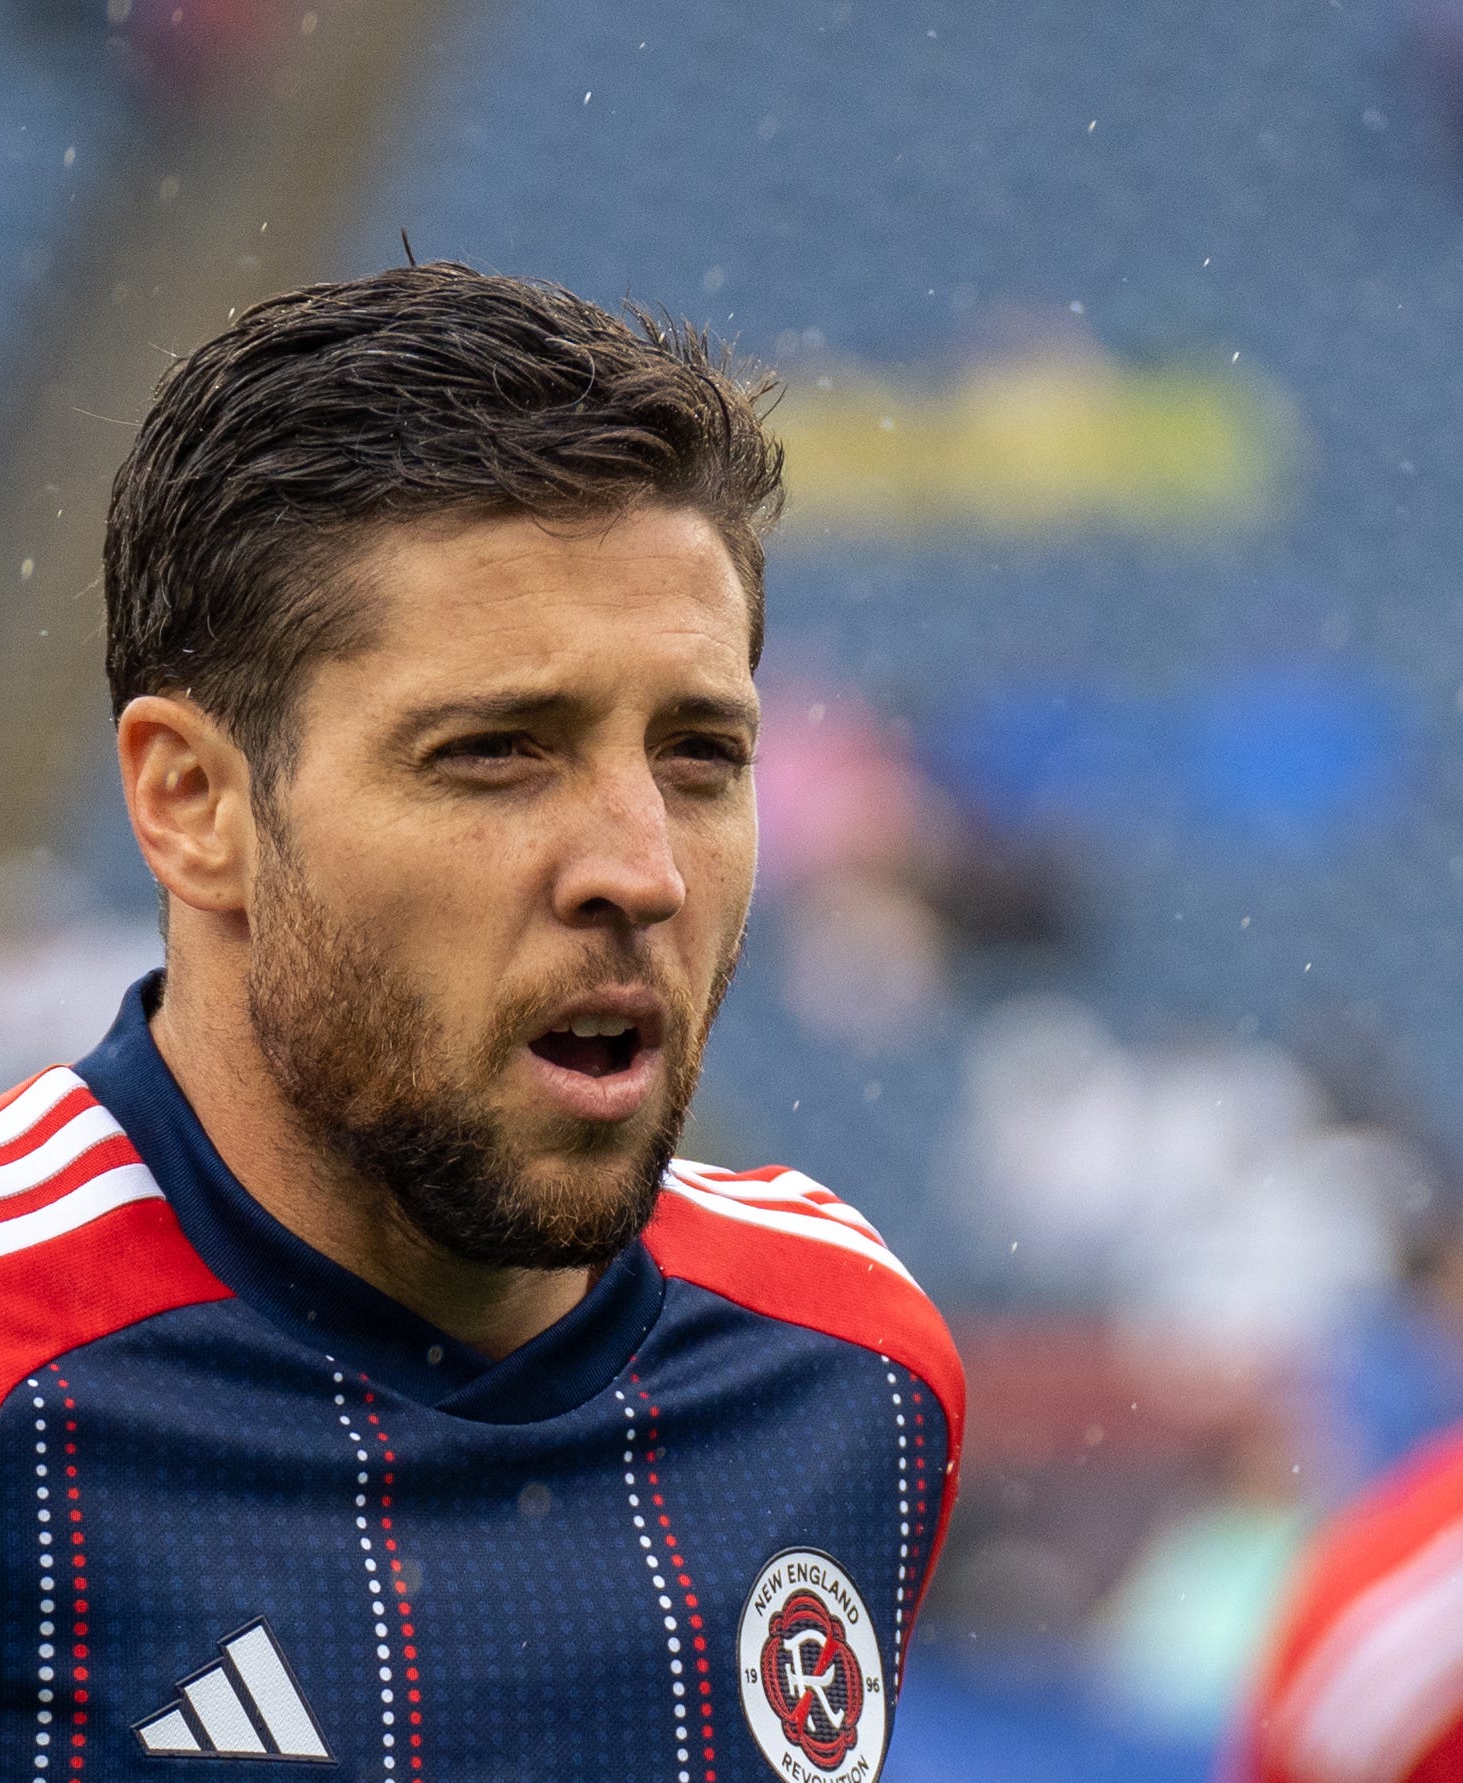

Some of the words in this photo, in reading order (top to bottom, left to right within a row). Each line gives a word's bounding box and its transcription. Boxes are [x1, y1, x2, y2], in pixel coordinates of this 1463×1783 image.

[753, 1568, 783, 1617] NEW
[788, 1562, 860, 1625] ENGLAND
[745, 1667, 758, 1684] 19
[865, 1677, 880, 1693] 96
